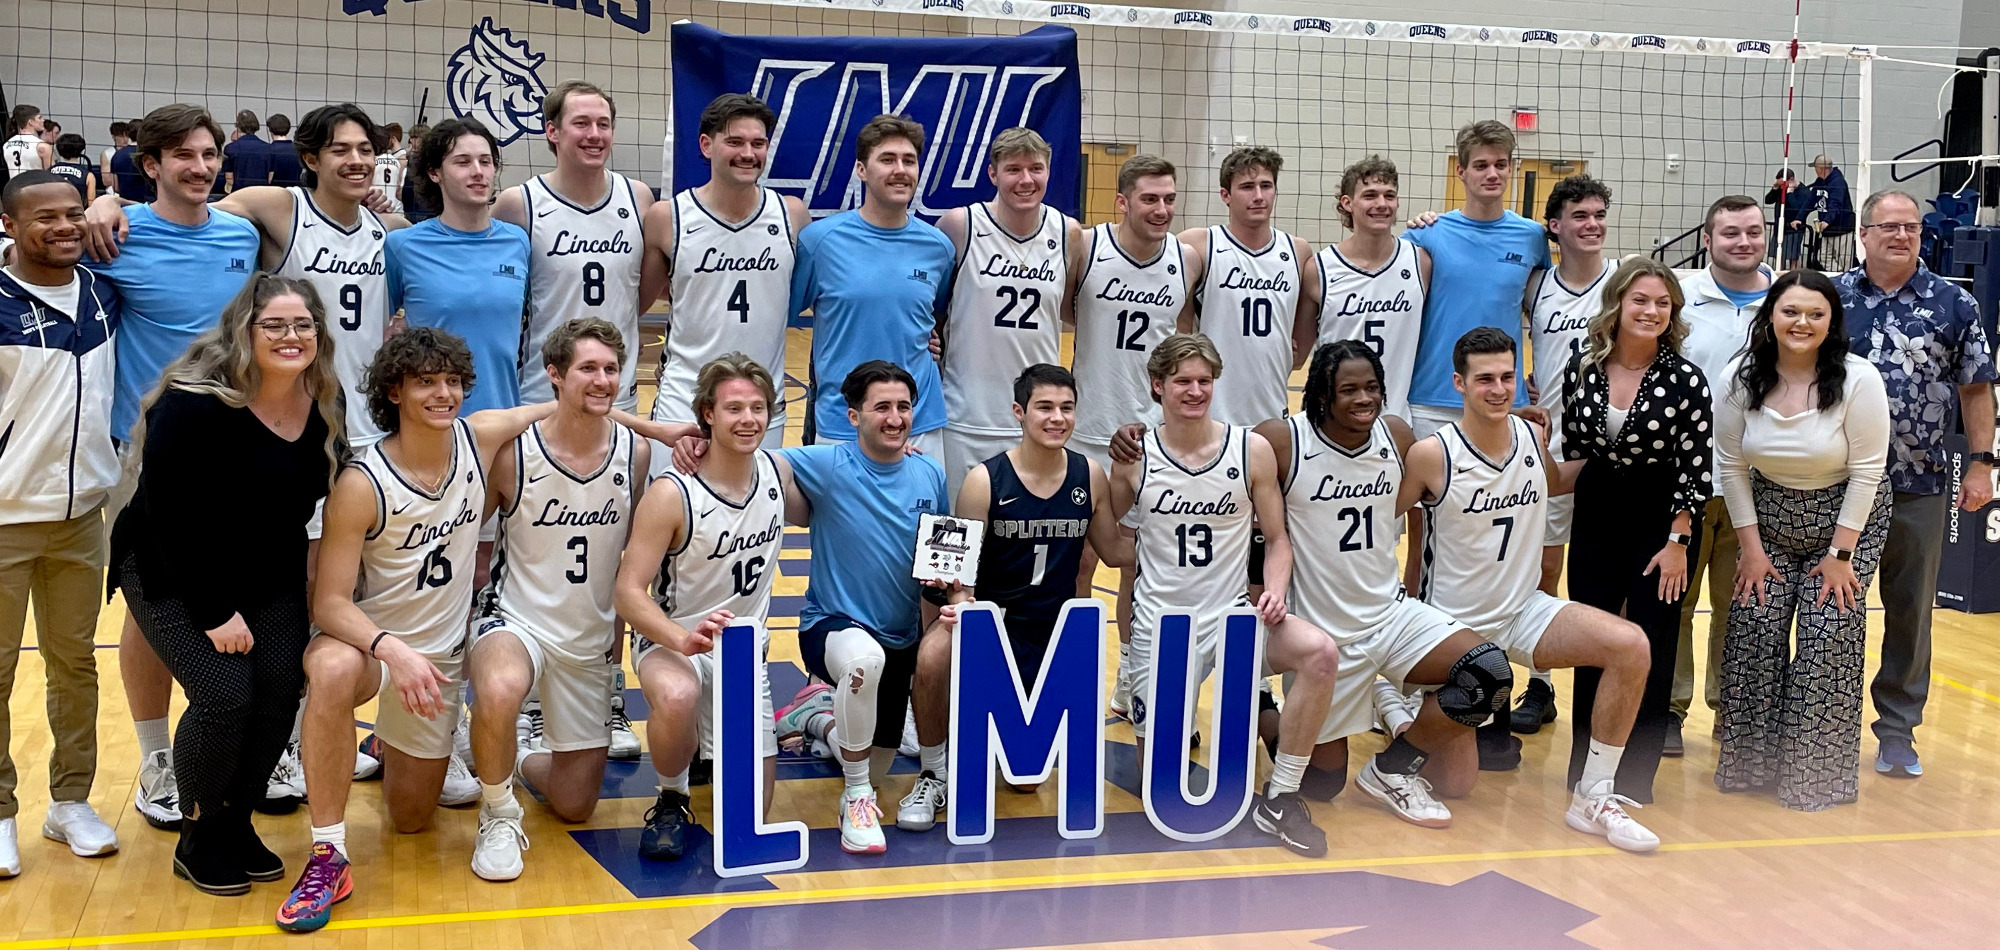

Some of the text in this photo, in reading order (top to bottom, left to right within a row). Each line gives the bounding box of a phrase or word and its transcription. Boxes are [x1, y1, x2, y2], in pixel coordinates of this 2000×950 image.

[1050, 4, 1091, 19] QUEENS
[1174, 11, 1212, 26] QUEENS
[1293, 18, 1331, 33] QUEENS
[1409, 25, 1446, 39] QUEENS
[1522, 30, 1558, 44] QUEENS
[1631, 35, 1666, 49] QUEENS
[1736, 41, 1771, 55] QUEENS
[741, 59, 1066, 217] LMU
[12, 150, 21, 166] 3
[51, 166, 82, 178] QUEENS
[383, 168, 391, 183] 6
[547, 230, 632, 257] Lincoln
[304, 247, 386, 275] Lincoln
[694, 246, 779, 273] Lincoln
[979, 254, 1056, 282] Lincoln
[582, 261, 605, 306] 8
[1096, 277, 1174, 307] Lincoln
[1219, 266, 1291, 293] Lincoln
[339, 284, 362, 331] 9
[727, 279, 750, 323] 4
[994, 285, 1042, 330] 22
[1337, 289, 1412, 317] Lincoln
[1912, 306, 1934, 318] LMU
[1115, 309, 1150, 352] 12
[1241, 296, 1273, 337] 10
[1543, 311, 1589, 335] Linc
[1364, 320, 1385, 358] 5
[1309, 470, 1393, 501] Lincoln
[1952, 452, 1962, 493] sports
[1150, 489, 1238, 515] Lincoln
[1462, 480, 1539, 514] Lincoln
[532, 498, 620, 526] Lincoln
[707, 514, 780, 560] Lincoln
[993, 519, 1089, 538] SPLITTERS
[1337, 505, 1374, 552] 21
[1492, 516, 1514, 562] 7
[1175, 523, 1213, 567] 13
[566, 536, 588, 584] 3
[1030, 544, 1048, 586] 1
[731, 555, 765, 597] 16
